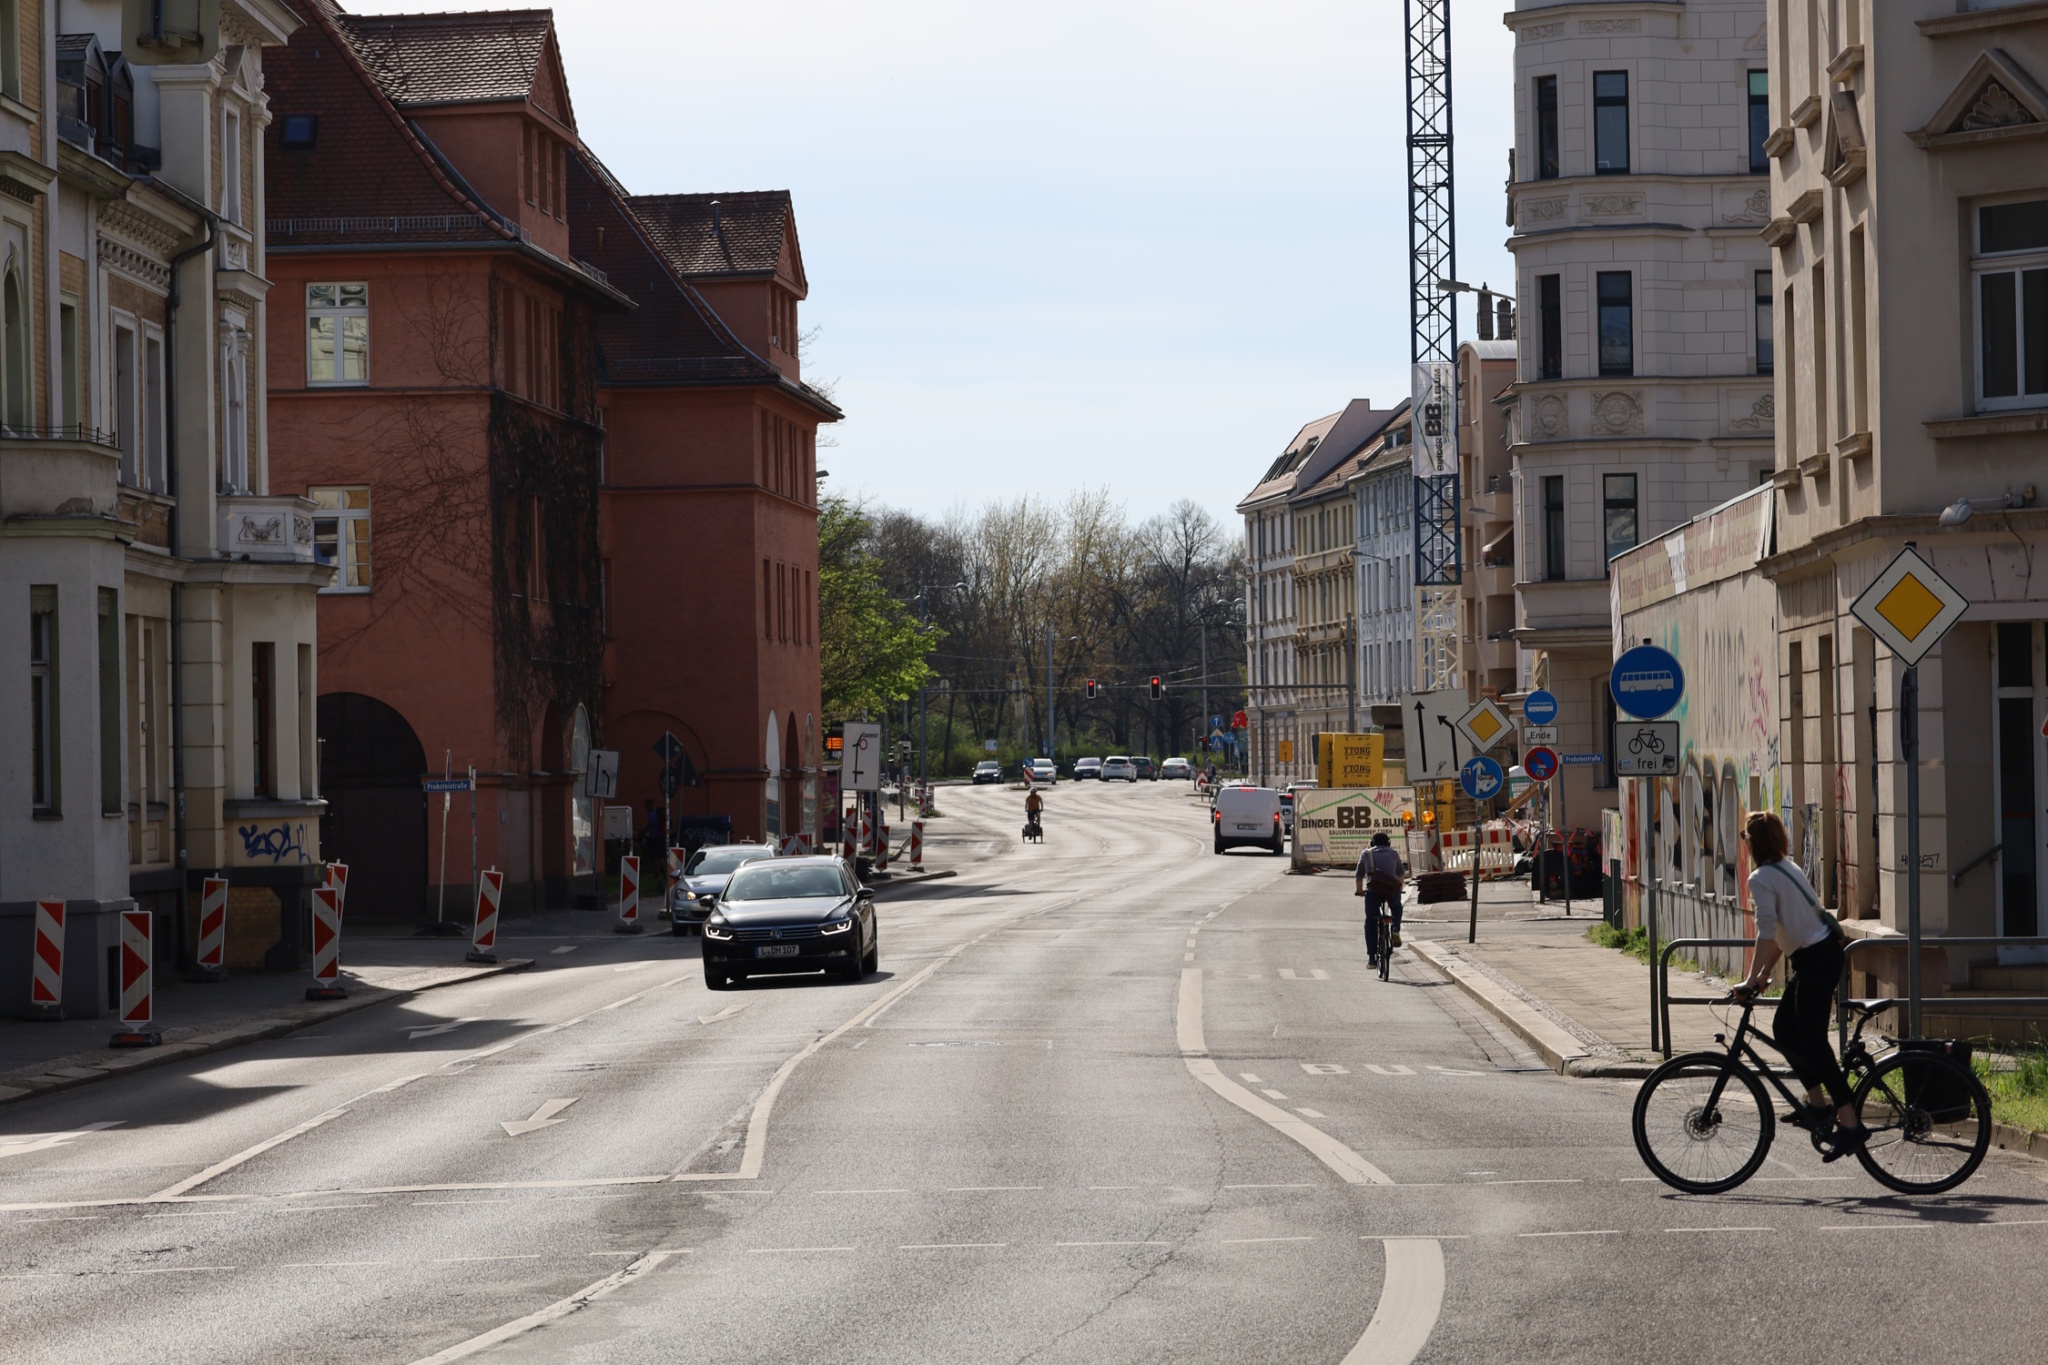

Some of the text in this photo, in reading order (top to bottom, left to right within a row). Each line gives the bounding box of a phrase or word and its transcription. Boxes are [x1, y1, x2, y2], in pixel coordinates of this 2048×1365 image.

[1425, 403, 1442, 436] BB
[1530, 731, 1551, 739] Ende
[1344, 746, 1371, 755] YTONG
[1565, 755, 1602, 763] Probsteistraße
[1637, 757, 1657, 769] frei
[1343, 764, 1371, 773] YTONG
[427, 782, 468, 790] Probsteistraße
[1337, 806, 1371, 828] BB
[1301, 819, 1335, 828] BINDER
[1373, 818, 1381, 828] &
